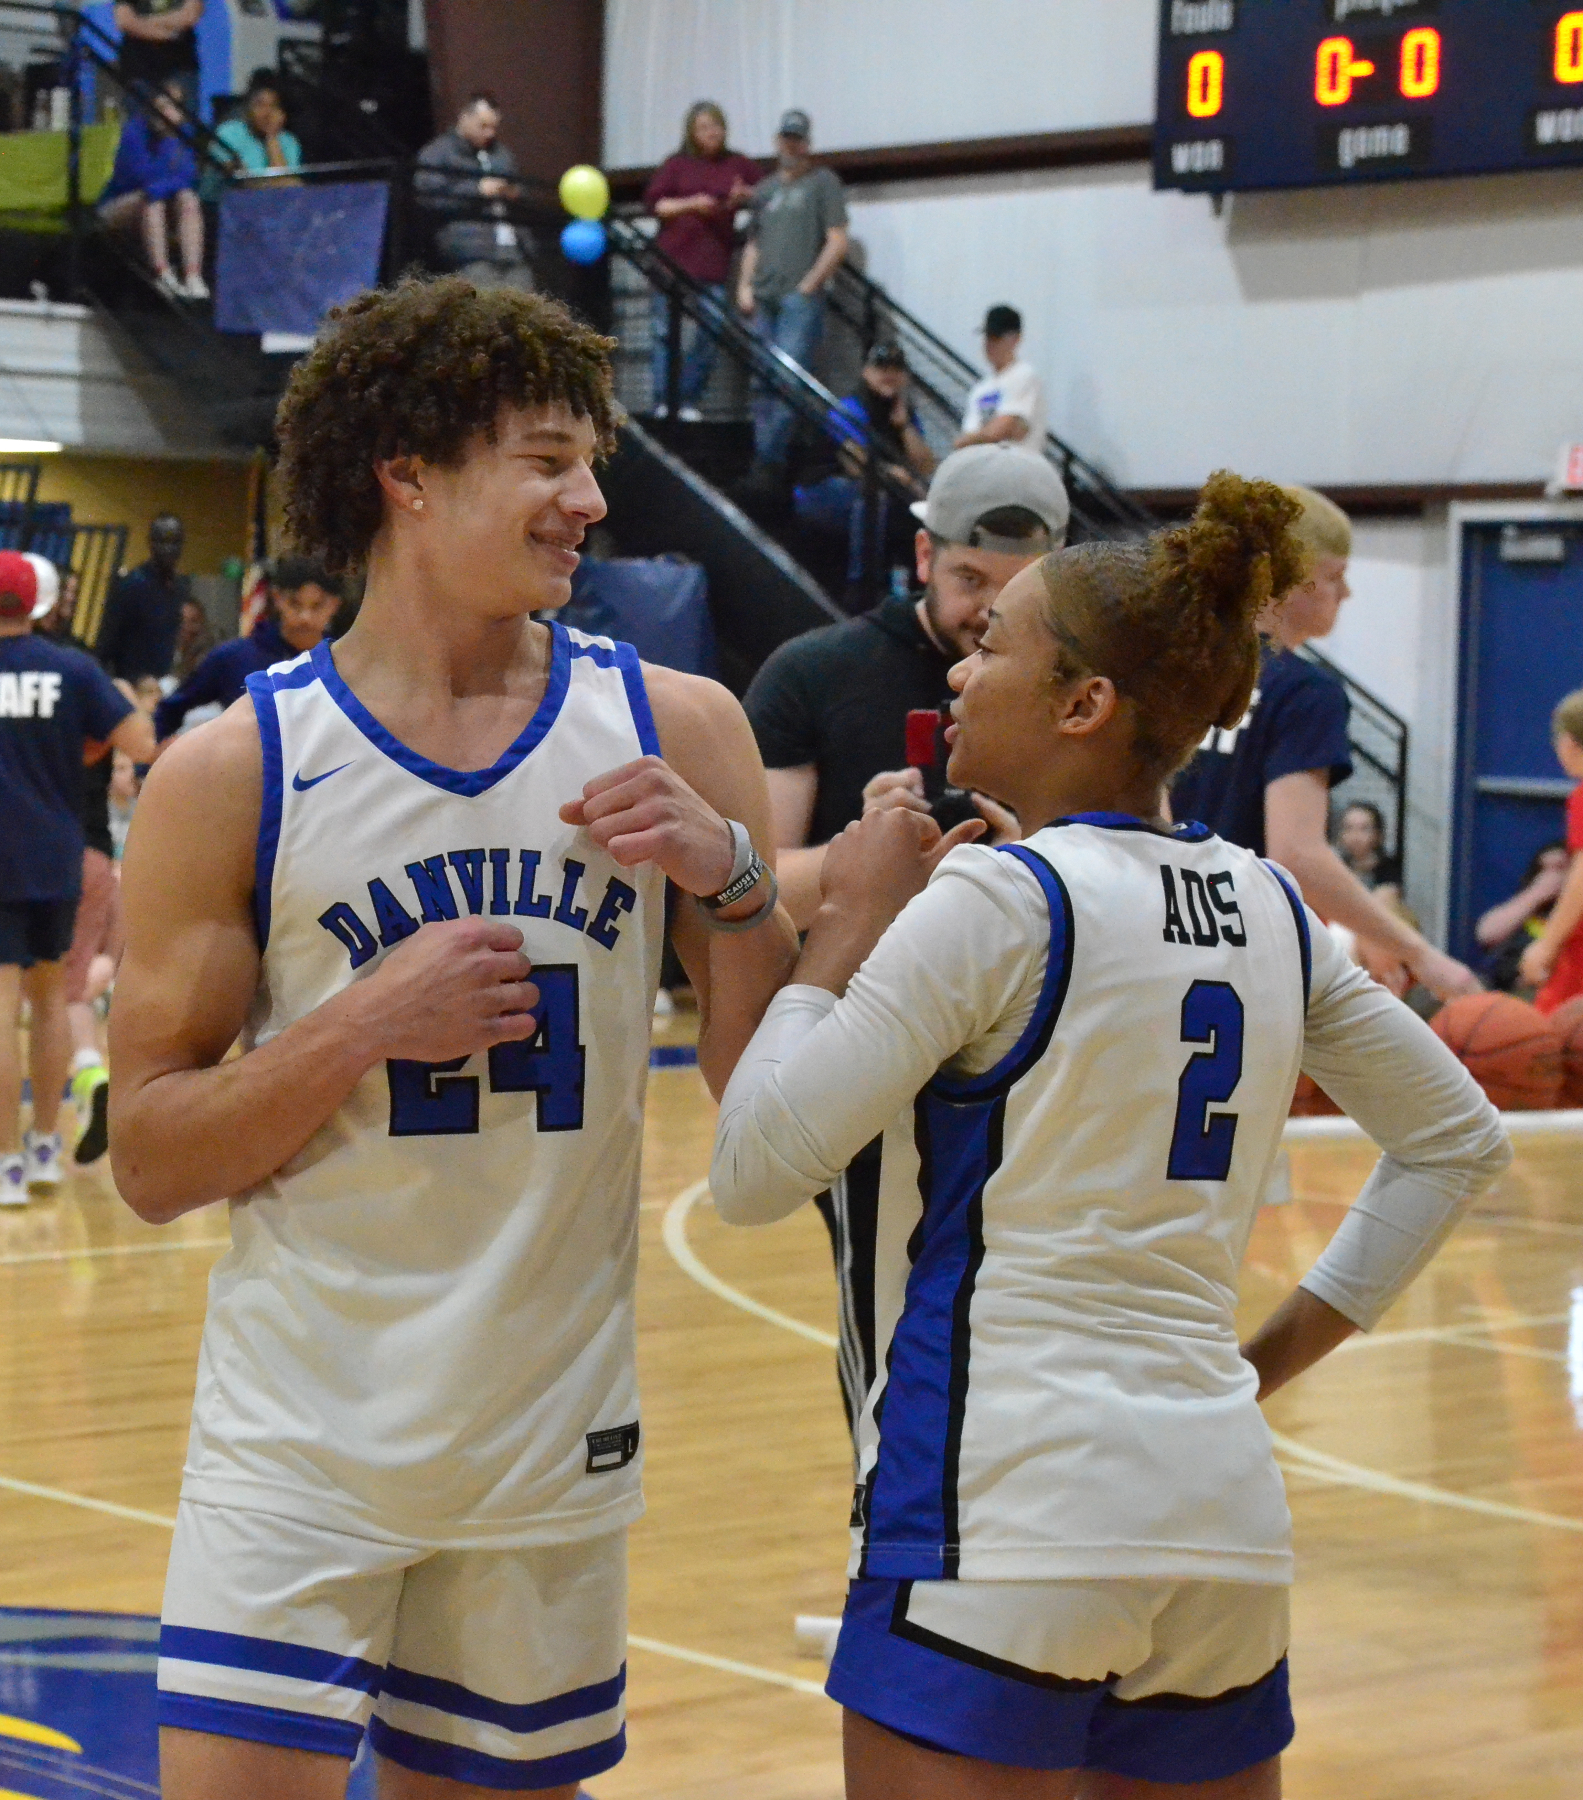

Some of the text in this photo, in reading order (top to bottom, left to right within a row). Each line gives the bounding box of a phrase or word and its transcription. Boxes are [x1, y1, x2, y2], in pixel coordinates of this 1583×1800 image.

[1187, 50, 1224, 118] 0
[1400, 27, 1442, 98] 0
[0, 671, 62, 719] AFF
[317, 848, 637, 970] DANVILLE
[717, 873, 751, 901] BECAUSE
[1160, 864, 1247, 948] ADS
[1166, 979, 1244, 1181] 2
